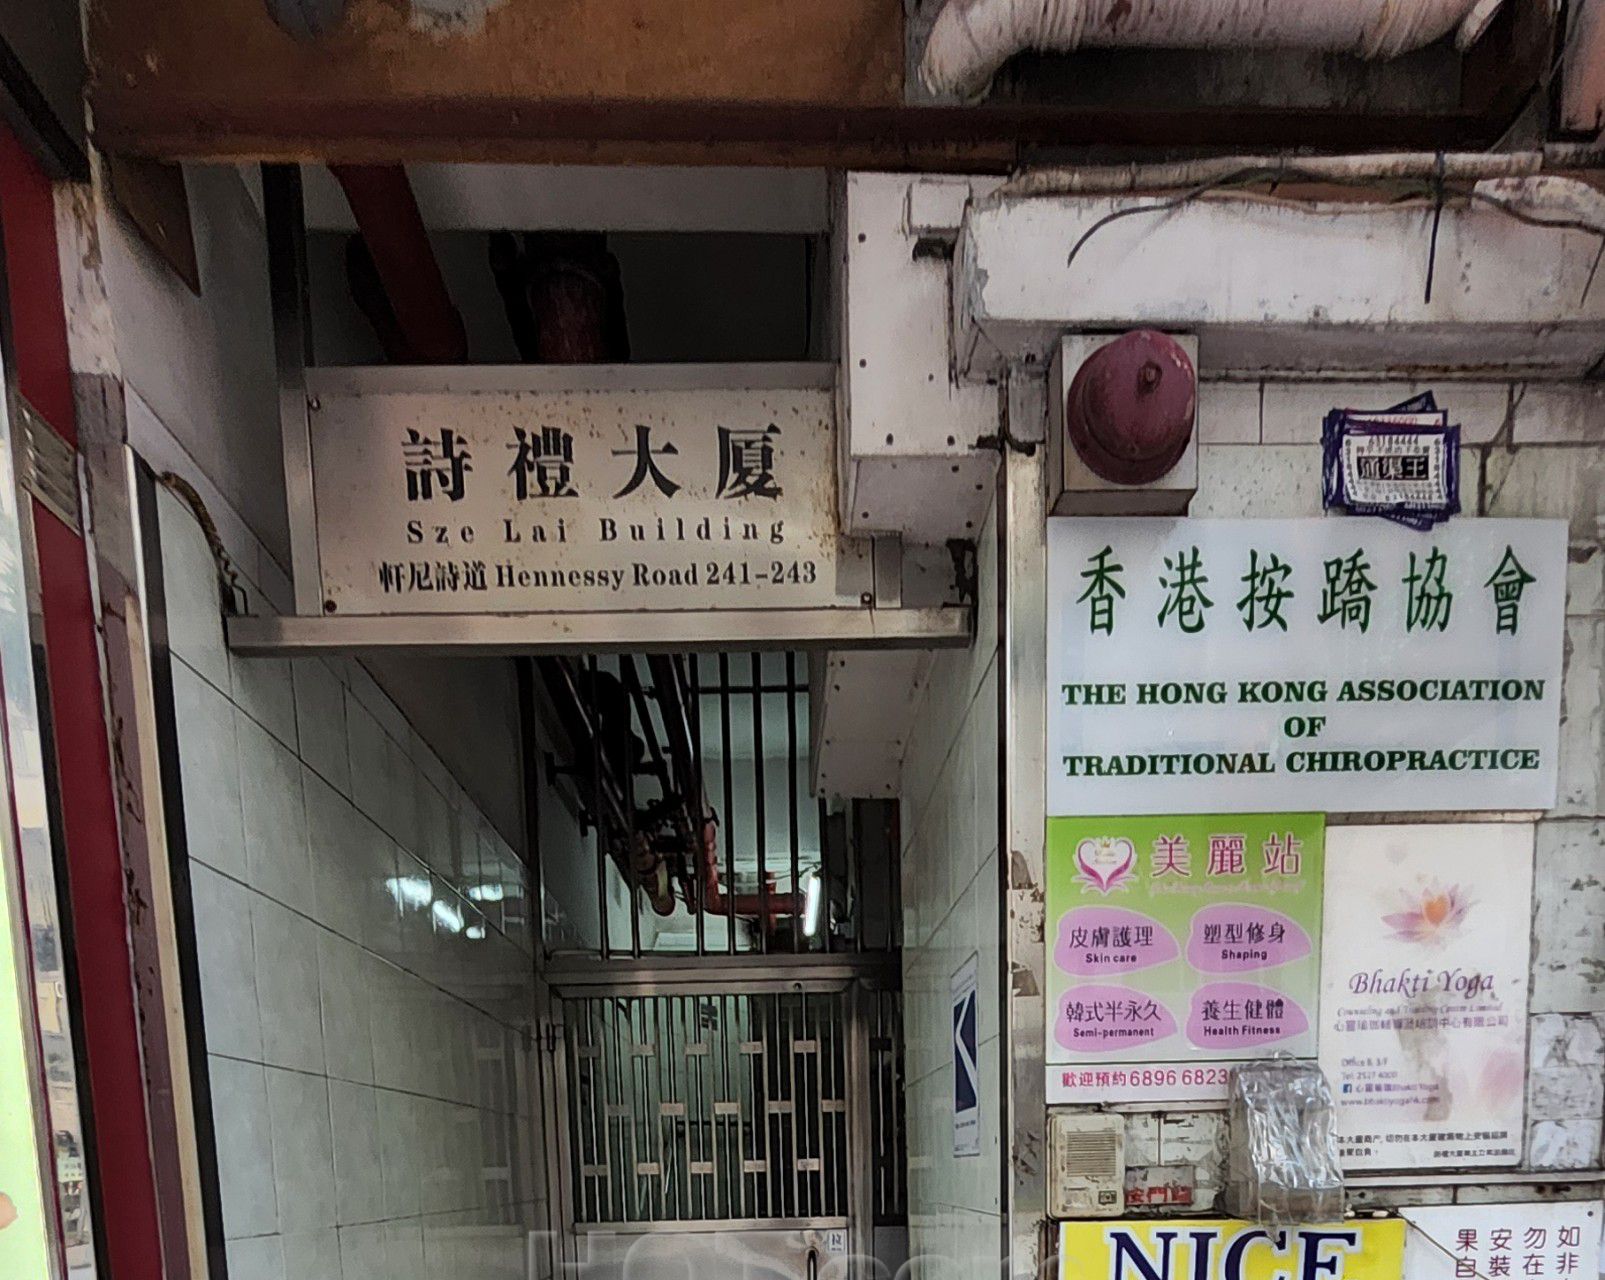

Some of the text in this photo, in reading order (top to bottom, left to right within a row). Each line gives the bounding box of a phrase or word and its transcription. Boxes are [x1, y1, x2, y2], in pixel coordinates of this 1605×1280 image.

[401, 424, 783, 501] 詩禮大廈
[407, 516, 786, 545] Sze Lai Building
[378, 560, 817, 594] 軒尼詩道 Hennessy Road 241-243
[1062, 679, 1545, 706] THE HONG KONG ASSOCIATION
[1283, 716, 1327, 739] OF
[1063, 749, 1540, 777] TRADITIONAL CHIROPRACTICE
[1151, 832, 1302, 877] 美麗站
[1069, 926, 1154, 948] 皮膚護理
[1203, 922, 1286, 945] 塑型修身
[1085, 953, 1138, 964] Skin care
[1221, 949, 1268, 961] Shaping
[1349, 967, 1495, 1000] Bhakti Yoga
[1066, 999, 1163, 1023] 韓式半永久
[1201, 998, 1284, 1021] 養生健體
[1072, 1027, 1155, 1038] Semi-permanent
[1203, 1025, 1282, 1036] Health Fitness
[1129, 1070, 1177, 1087] 6896
